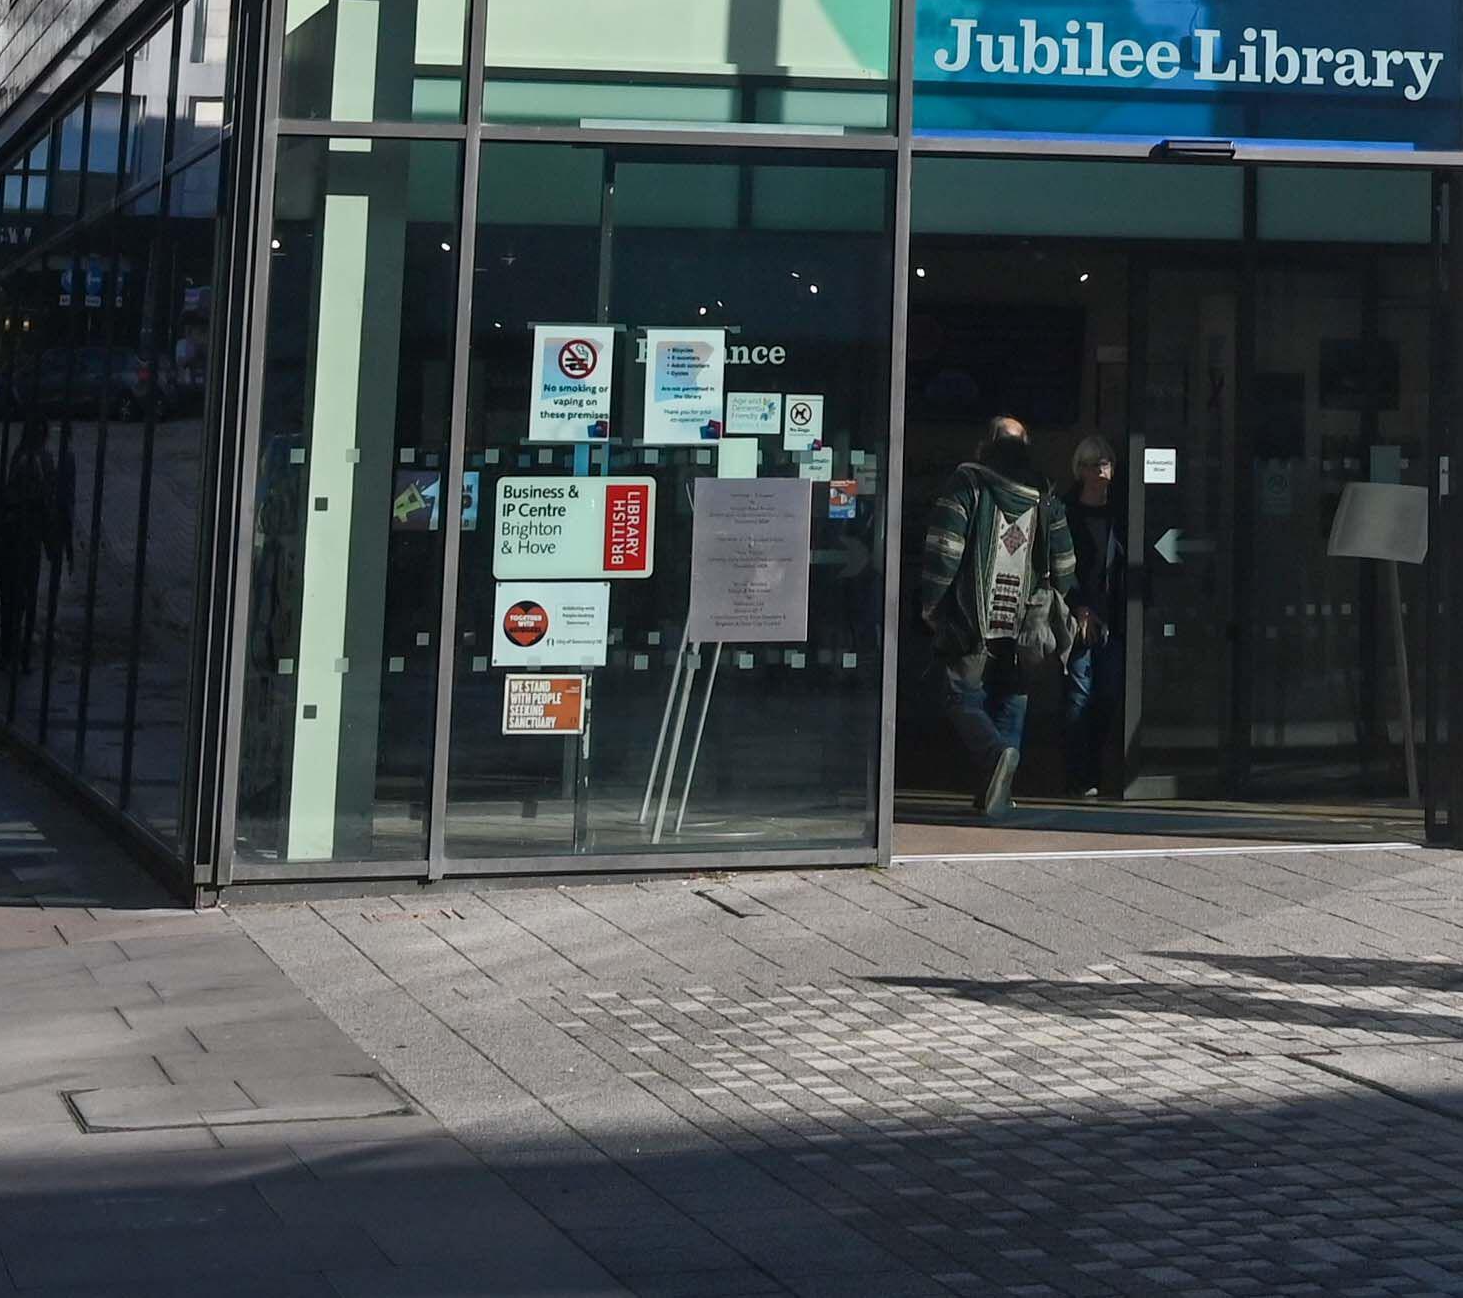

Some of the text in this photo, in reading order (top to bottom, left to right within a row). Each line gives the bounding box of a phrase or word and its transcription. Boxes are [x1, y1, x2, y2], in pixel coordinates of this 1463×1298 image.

[934, 18, 1444, 102] Jubilee Library
[544, 384, 556, 393] No
[559, 384, 597, 395] smoking
[553, 398, 598, 408] vaping on
[540, 411, 609, 421] these premises
[503, 484, 579, 499] Business &
[502, 503, 567, 518] IP Centre
[501, 521, 562, 540] Brighton
[626, 491, 640, 557] LIBRARY
[611, 500, 626, 565] BRITISH
[501, 540, 556, 555] & Hove
[511, 680, 524, 692] WE
[525, 681, 551, 692] STAND
[510, 692, 562, 704] WITH PEOPLE
[509, 704, 544, 716] SEEKING
[508, 716, 557, 729] SANCTUARY
